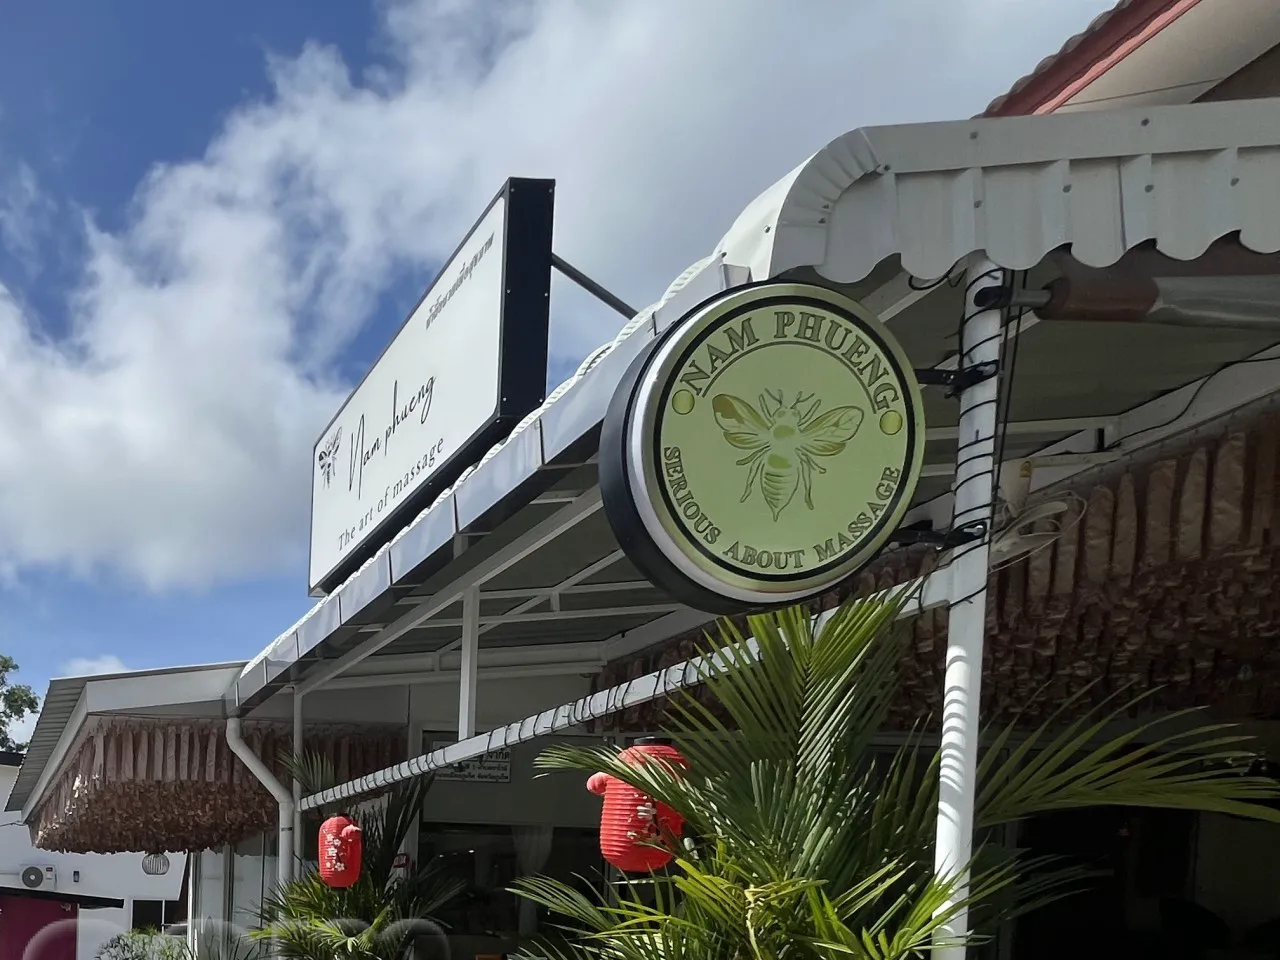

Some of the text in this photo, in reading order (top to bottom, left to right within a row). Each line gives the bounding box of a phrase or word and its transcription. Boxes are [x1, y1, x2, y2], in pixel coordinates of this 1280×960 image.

[679, 311, 901, 411] NAM PHUENG
[338, 437, 444, 551] The art of massage
[348, 375, 436, 500] Nam phueng
[663, 446, 902, 570] SERIOUS ABOUT MASSAGE
